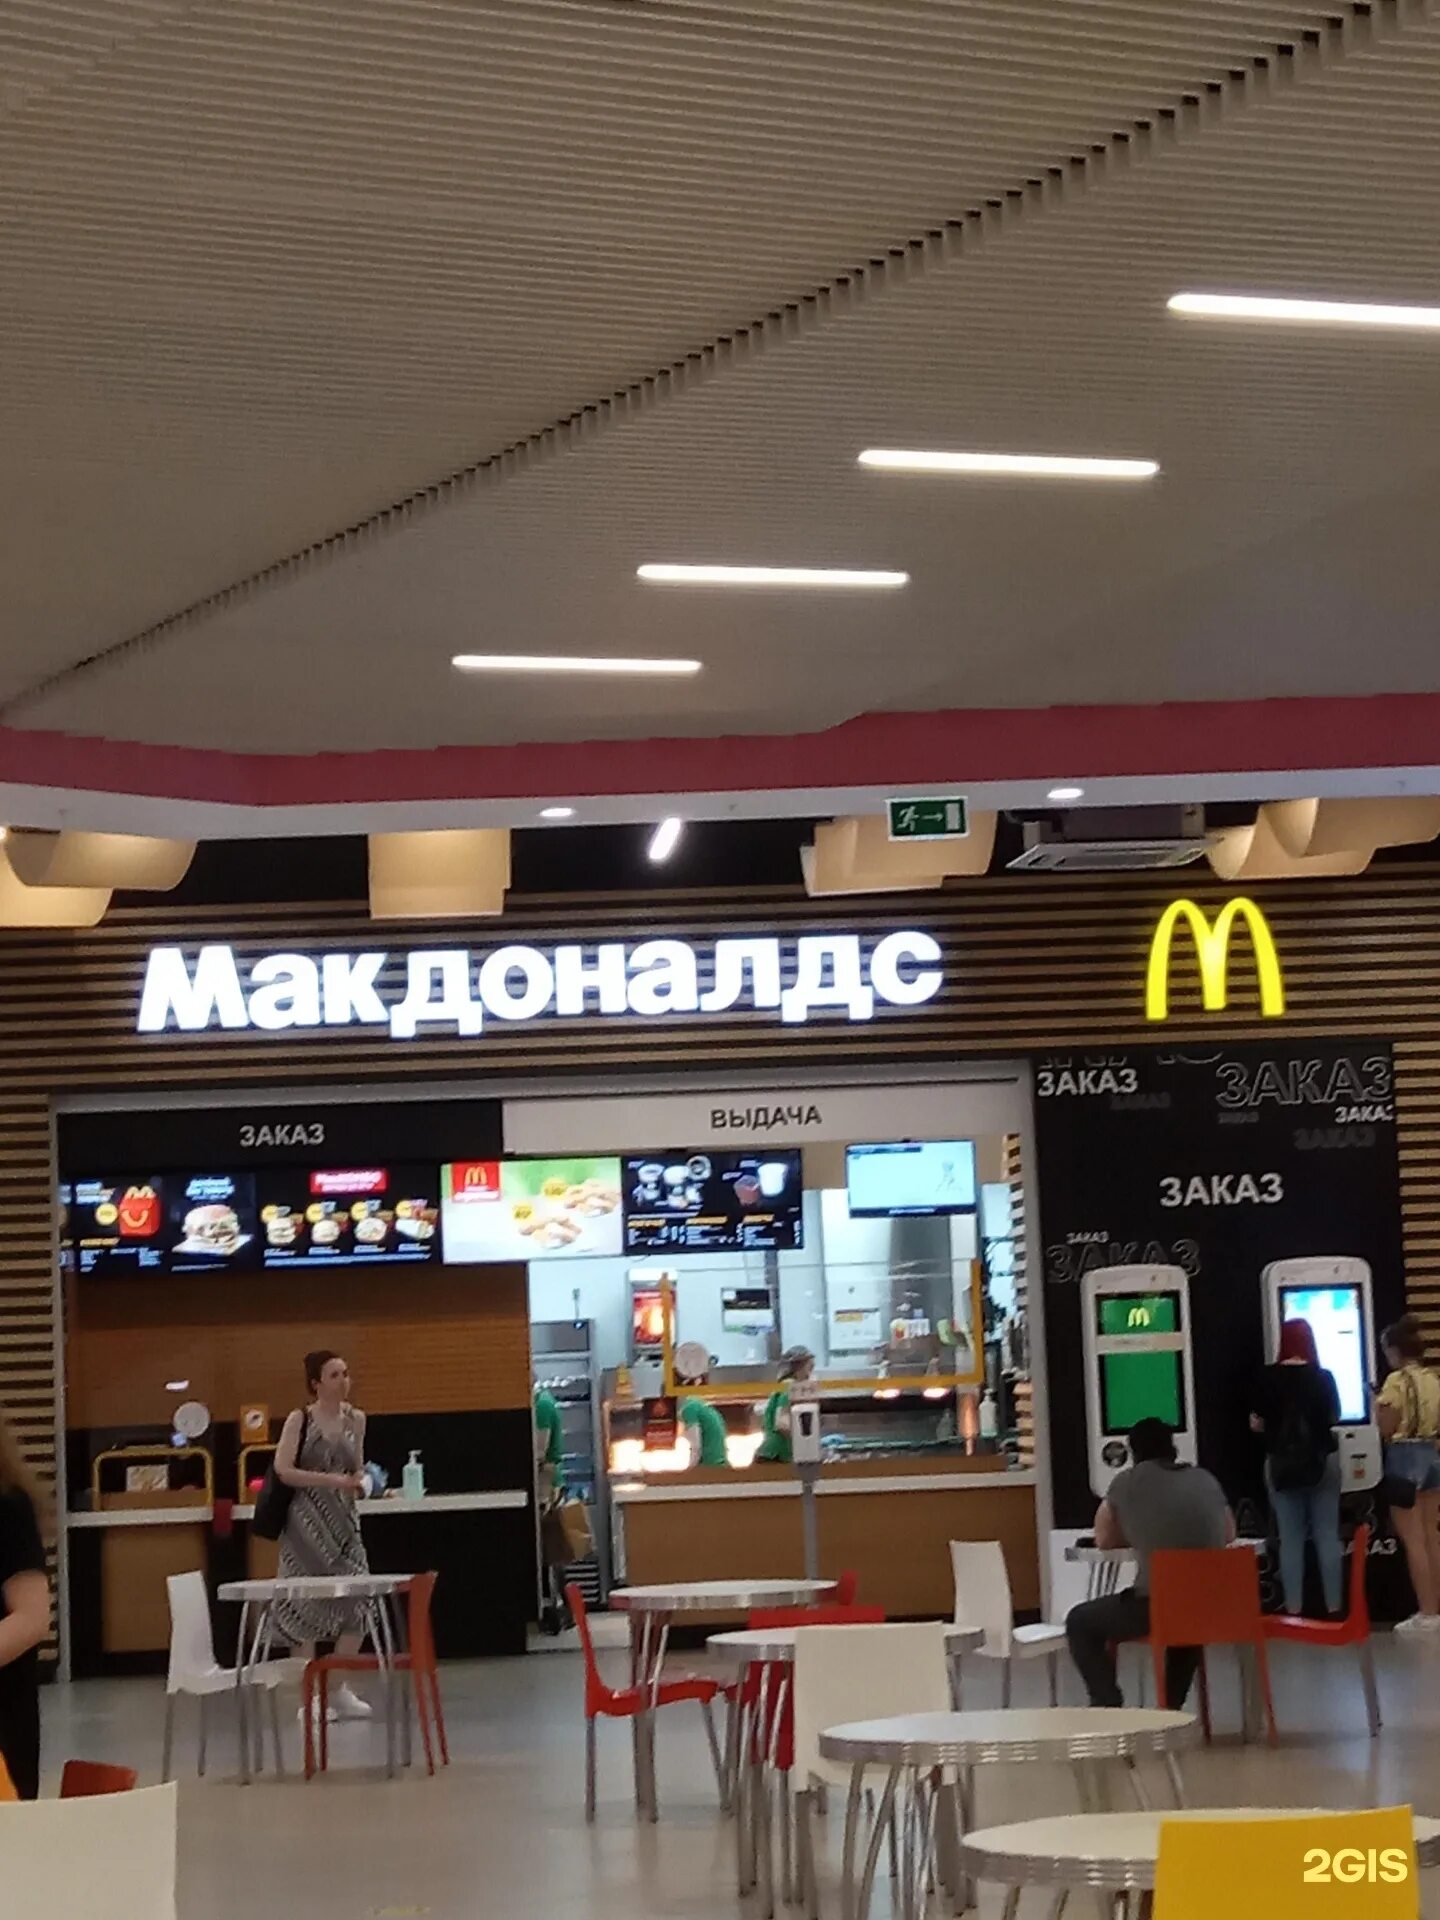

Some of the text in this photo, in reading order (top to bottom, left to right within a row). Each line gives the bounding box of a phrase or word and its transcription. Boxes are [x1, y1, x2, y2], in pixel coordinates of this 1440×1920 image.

[137, 930, 944, 1039] Макдоналдс
[1037, 1068, 1138, 1097] ЗАКАЗ
[711, 1105, 822, 1131] ВЫДАЧА
[240, 1122, 325, 1147] ЗАКАЗ
[1159, 1172, 1284, 1207] ЗАКАЗ
